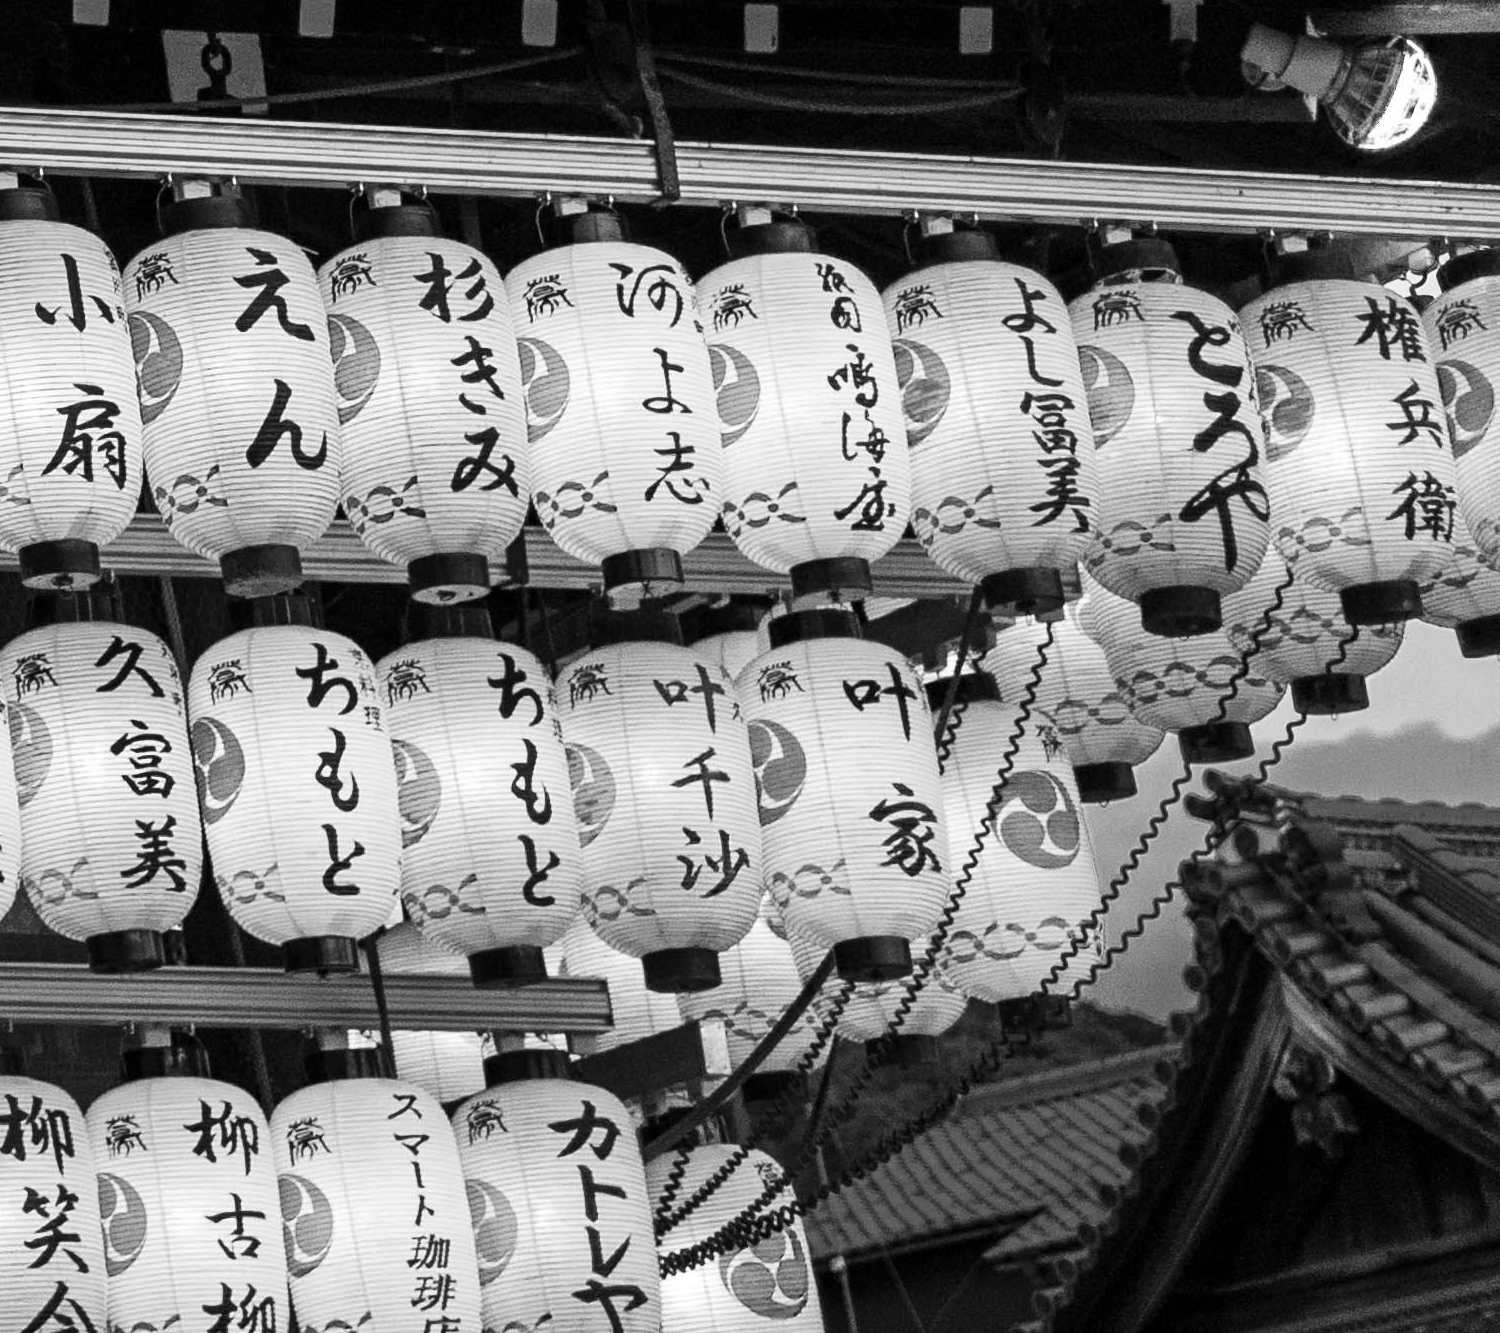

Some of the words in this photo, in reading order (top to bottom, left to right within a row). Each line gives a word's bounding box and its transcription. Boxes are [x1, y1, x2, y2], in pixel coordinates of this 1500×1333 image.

[33, 253, 127, 491] 小扇
[233, 247, 329, 471] えん
[413, 251, 520, 499] 杉きみ
[1354, 295, 1456, 543] 権兵衛
[95, 635, 187, 893] 久富美
[295, 641, 367, 896] ちもと
[488, 652, 561, 907] ちもと
[843, 662, 942, 877] 叶家
